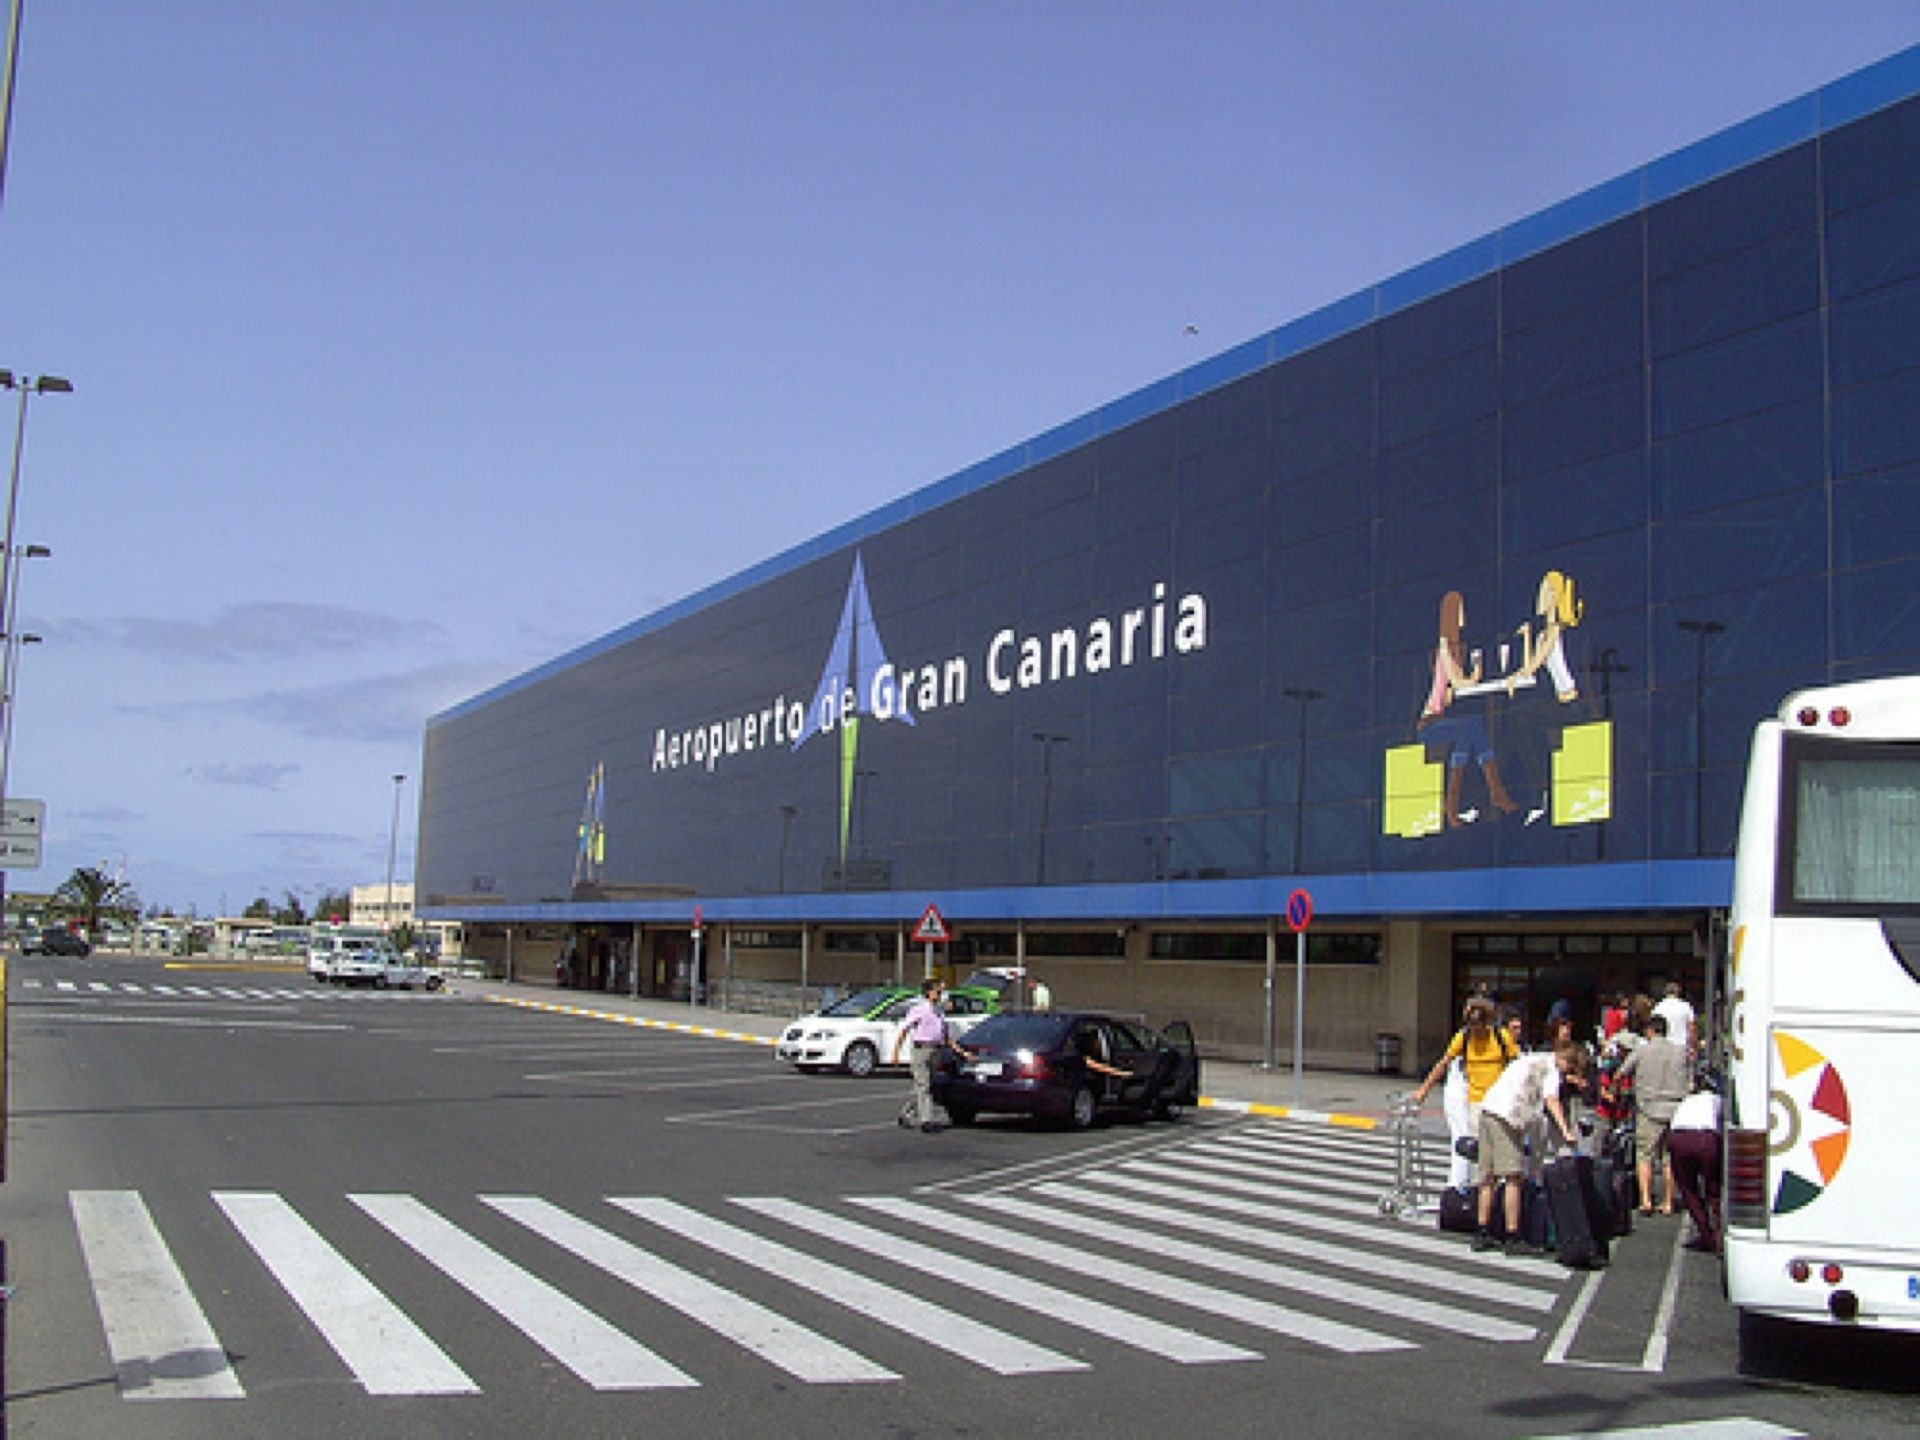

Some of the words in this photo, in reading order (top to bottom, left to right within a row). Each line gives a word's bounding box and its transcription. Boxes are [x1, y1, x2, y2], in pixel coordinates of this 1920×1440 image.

[652, 695, 804, 773] Aeropuerto
[819, 675, 857, 734] de
[870, 656, 968, 720] Gran
[987, 582, 1207, 692] Canaria
